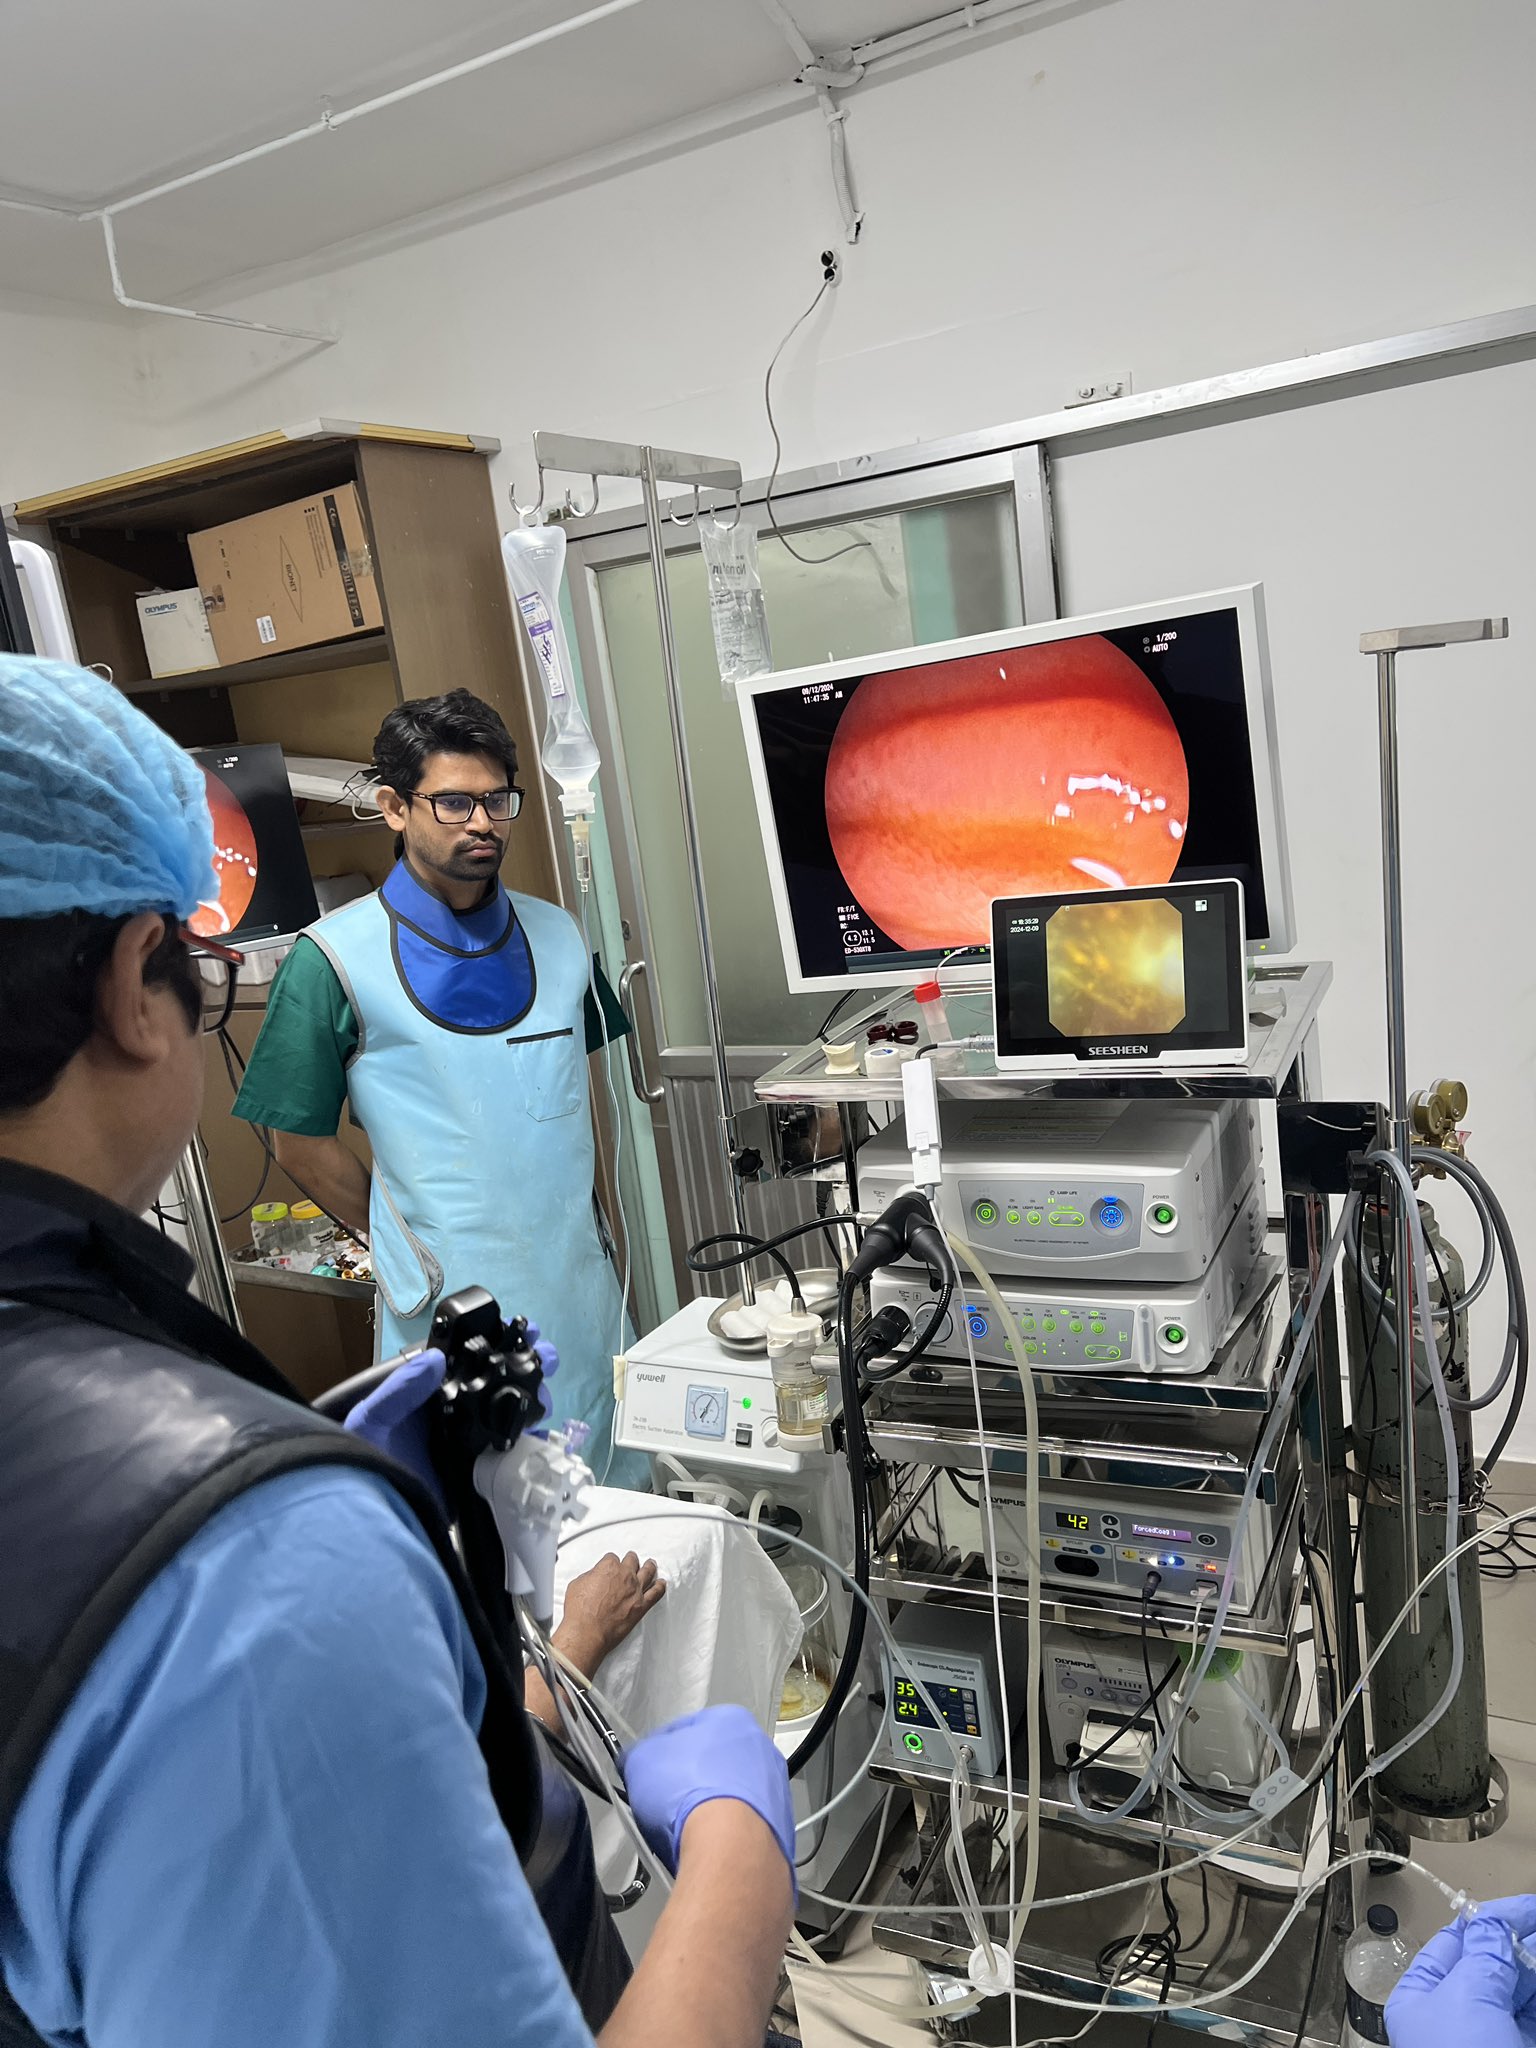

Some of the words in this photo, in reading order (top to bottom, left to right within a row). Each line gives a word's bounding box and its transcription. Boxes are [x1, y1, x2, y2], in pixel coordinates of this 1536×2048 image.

[285, 563, 298, 593] BIONET
[144, 602, 178, 614] OLYMPUS
[1156, 631, 1178, 643] 1/200
[1152, 642, 1169, 653] AUTO
[847, 934, 859, 942] 4.2
[1088, 1045, 1149, 1056] SEESHEEN
[636, 1372, 666, 1383] yuwell
[1067, 1514, 1088, 1529] 42
[1054, 1657, 1097, 1670] OLYMPUS
[897, 1681, 915, 1697] 35
[898, 1701, 918, 1716] 2.4
